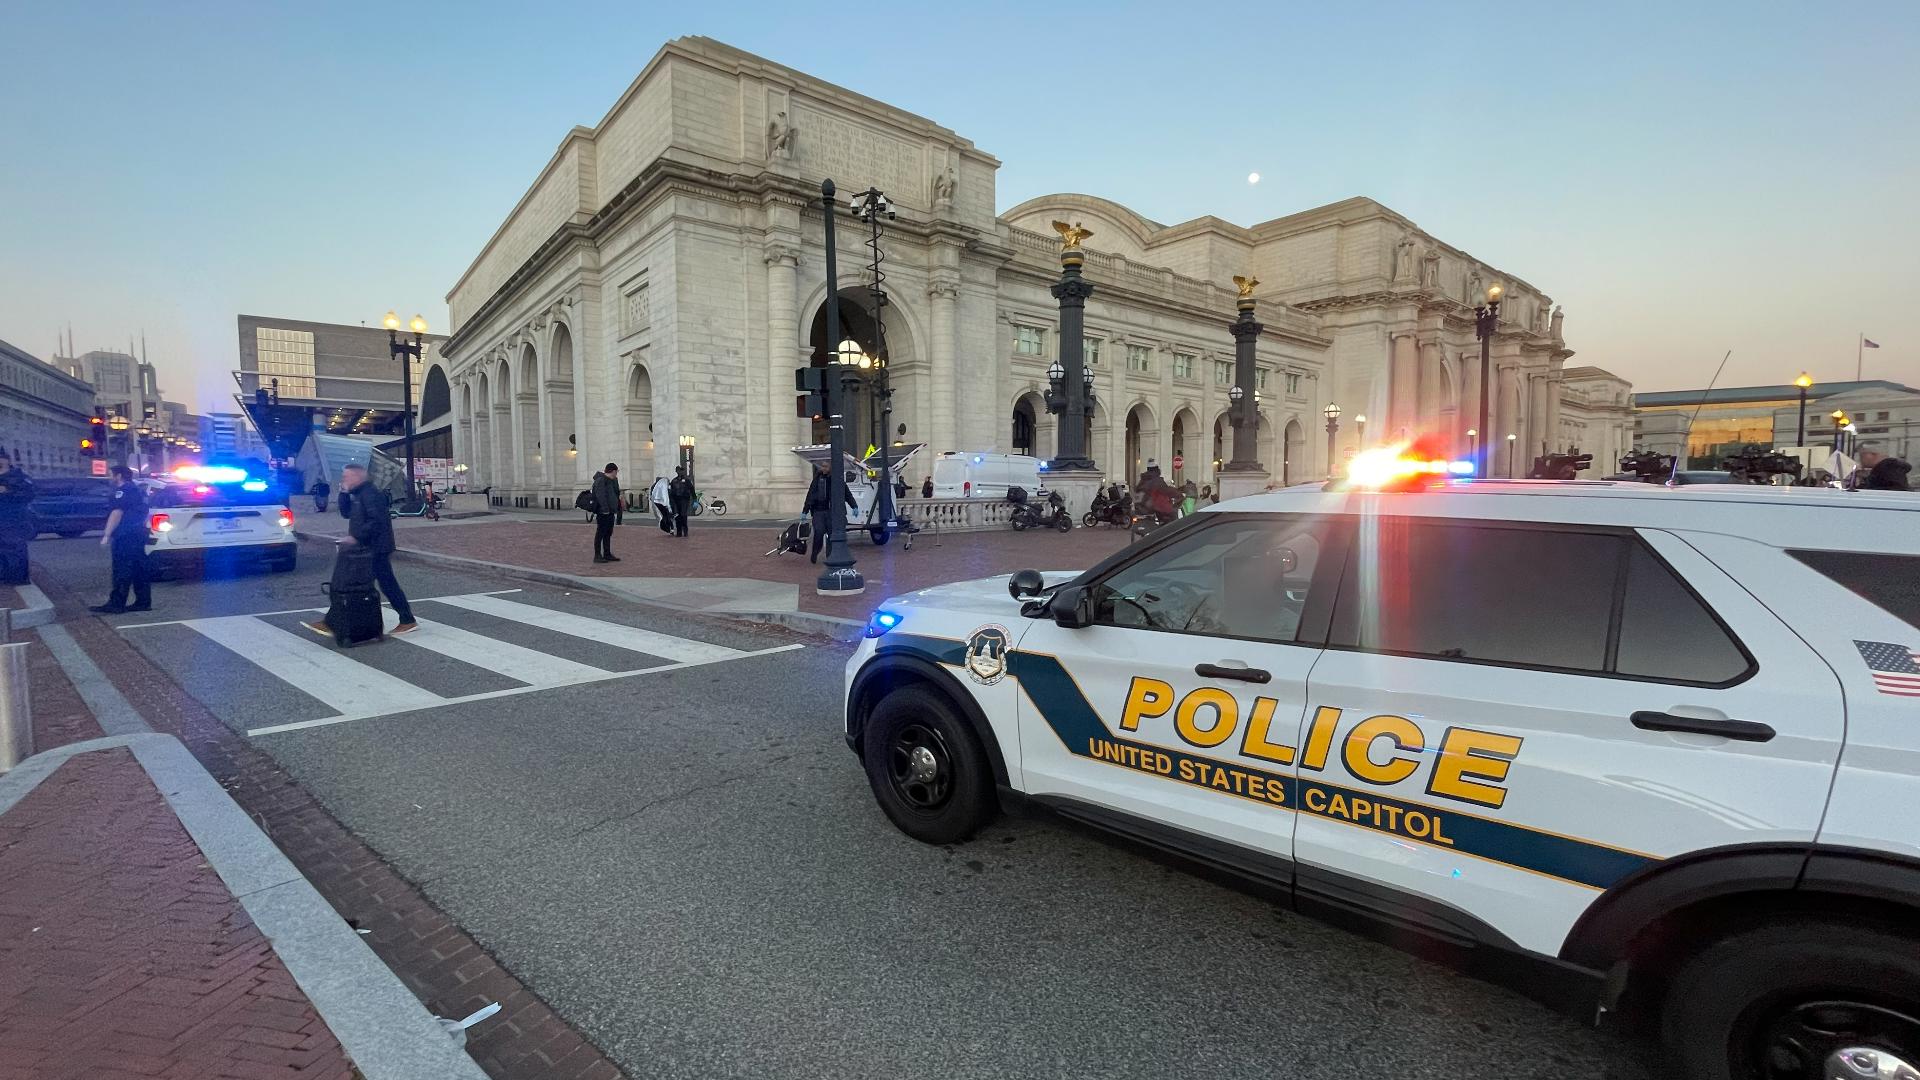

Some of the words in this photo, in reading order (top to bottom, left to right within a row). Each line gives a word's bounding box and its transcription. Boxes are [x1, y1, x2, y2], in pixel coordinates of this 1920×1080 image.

[1089, 737, 1173, 776] UNITED
[1178, 759, 1285, 803] STATES
[1305, 788, 1454, 845] CAPITOL
[1118, 675, 1524, 809] POLICE
